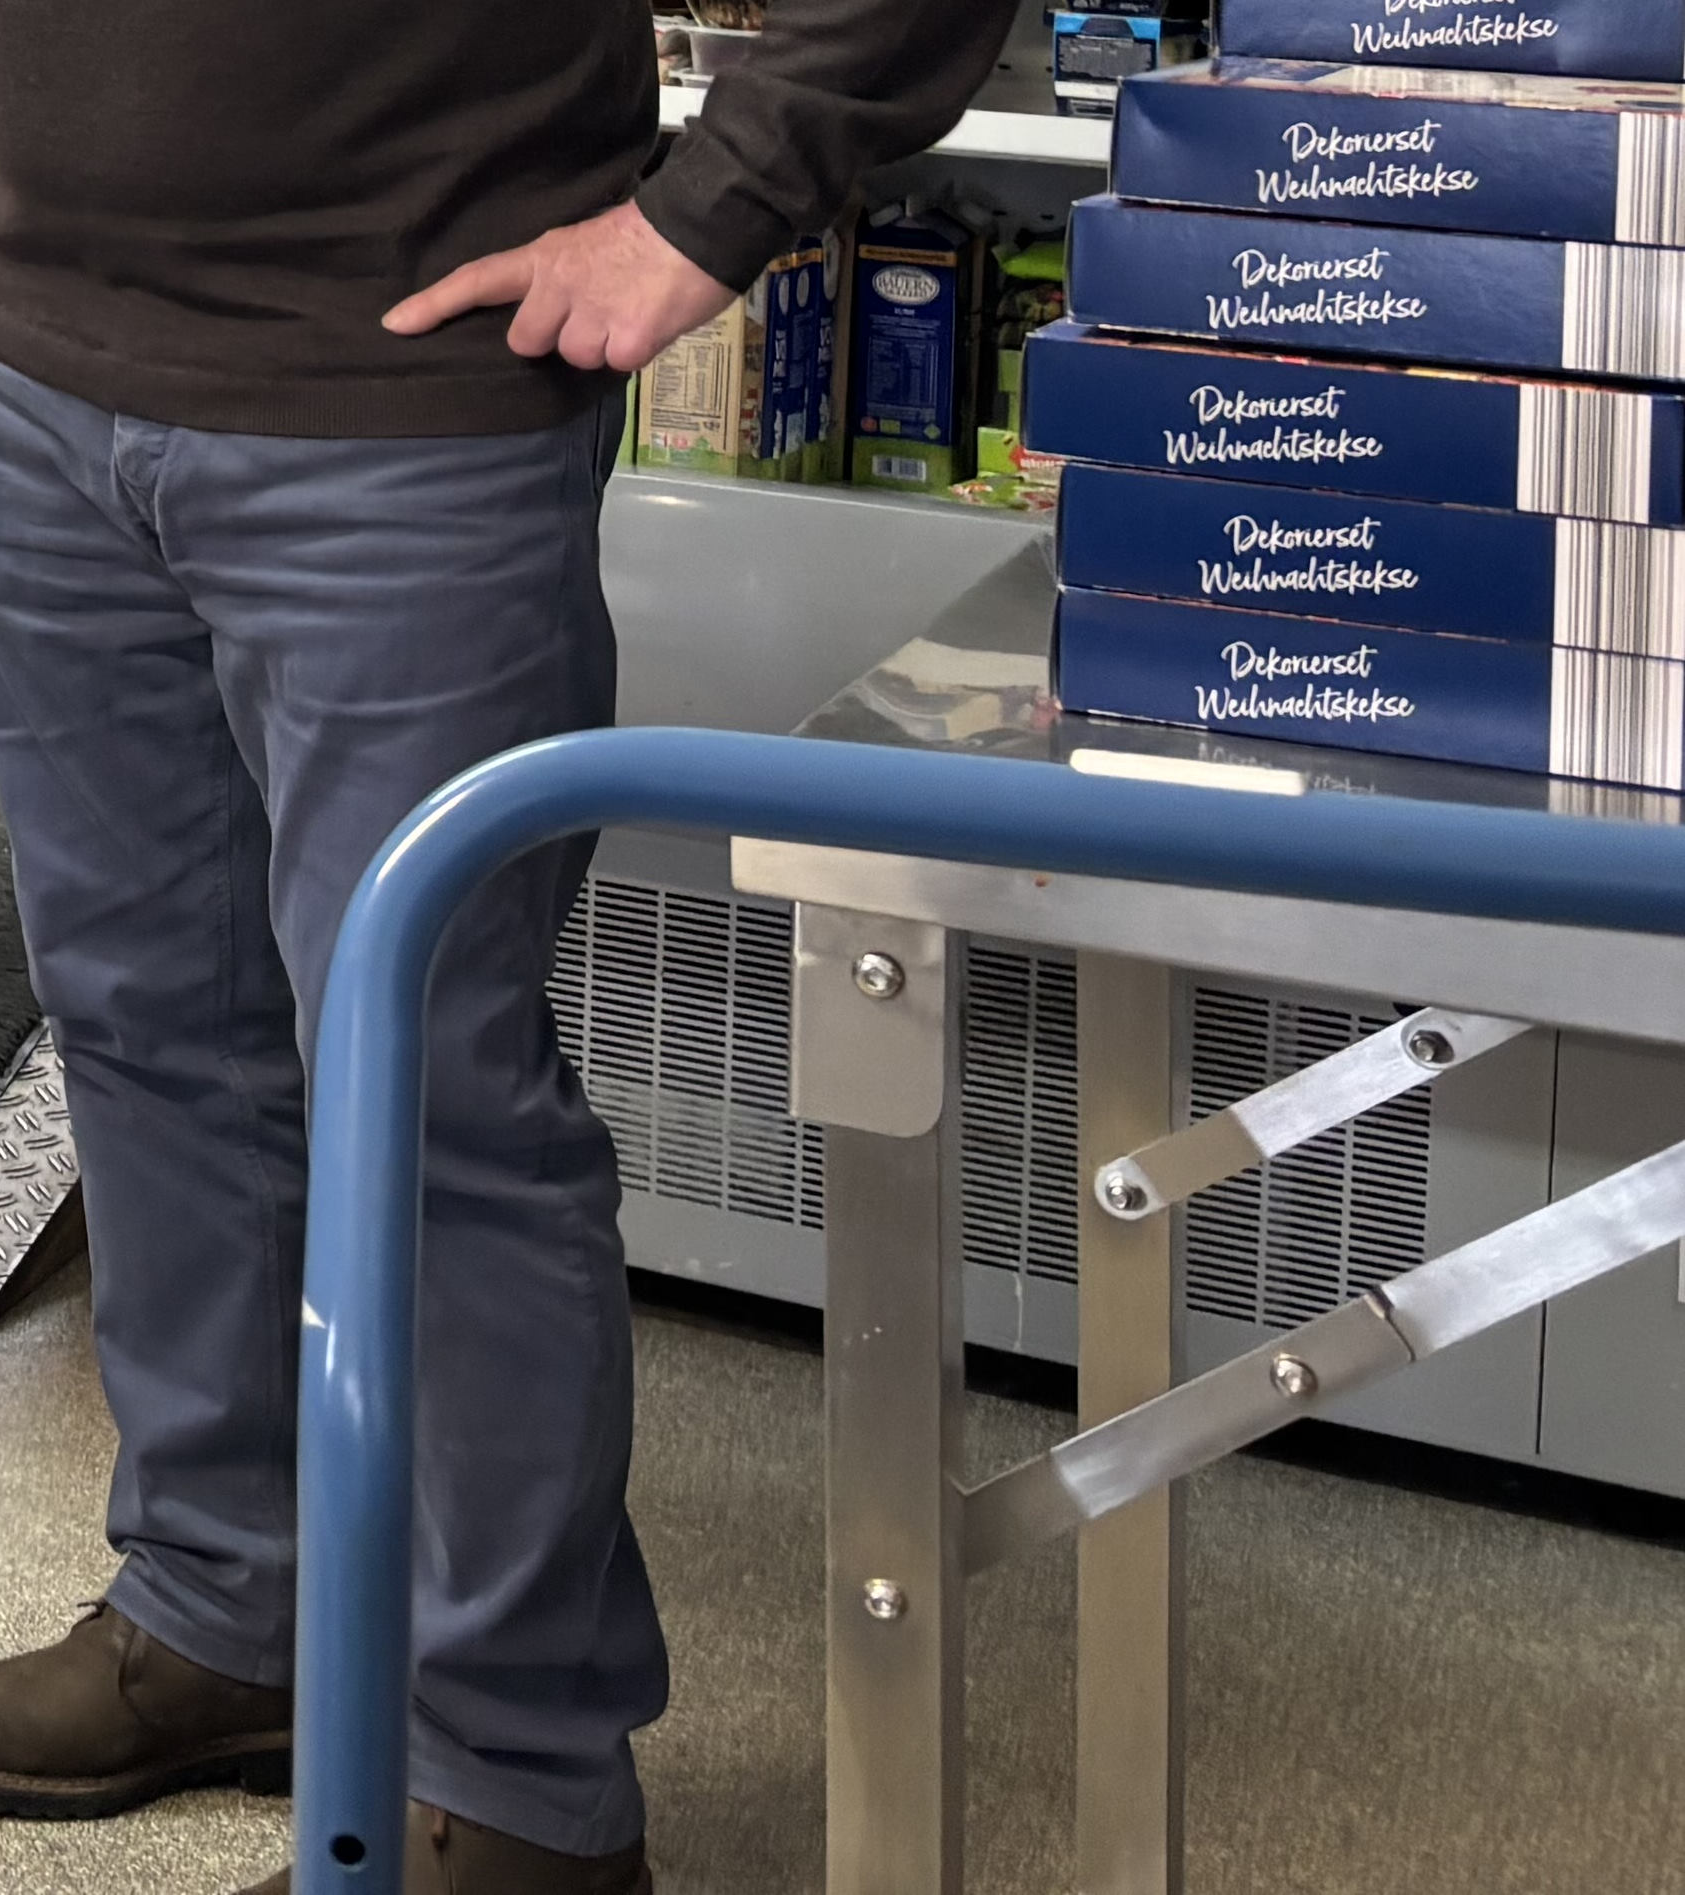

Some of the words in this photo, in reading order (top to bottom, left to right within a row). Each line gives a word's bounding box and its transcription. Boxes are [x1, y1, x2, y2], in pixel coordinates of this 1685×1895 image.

[1350, 13, 1559, 54] Weihnachtskekse
[1281, 119, 1442, 162] Dekorierset
[1255, 161, 1479, 203] Weihnachtskekse
[1232, 247, 1391, 289] Dekorierset
[1205, 288, 1428, 329] Weihnachtskekse
[1189, 385, 1346, 424] Dekorierset
[1163, 425, 1383, 464] Weihnachtskekse
[1223, 514, 1381, 556] Dekorierset
[1197, 556, 1419, 595] Weihnachtskekse
[1221, 640, 1378, 682] Dekorierset
[1194, 682, 1416, 723] Weihnachtskekse
